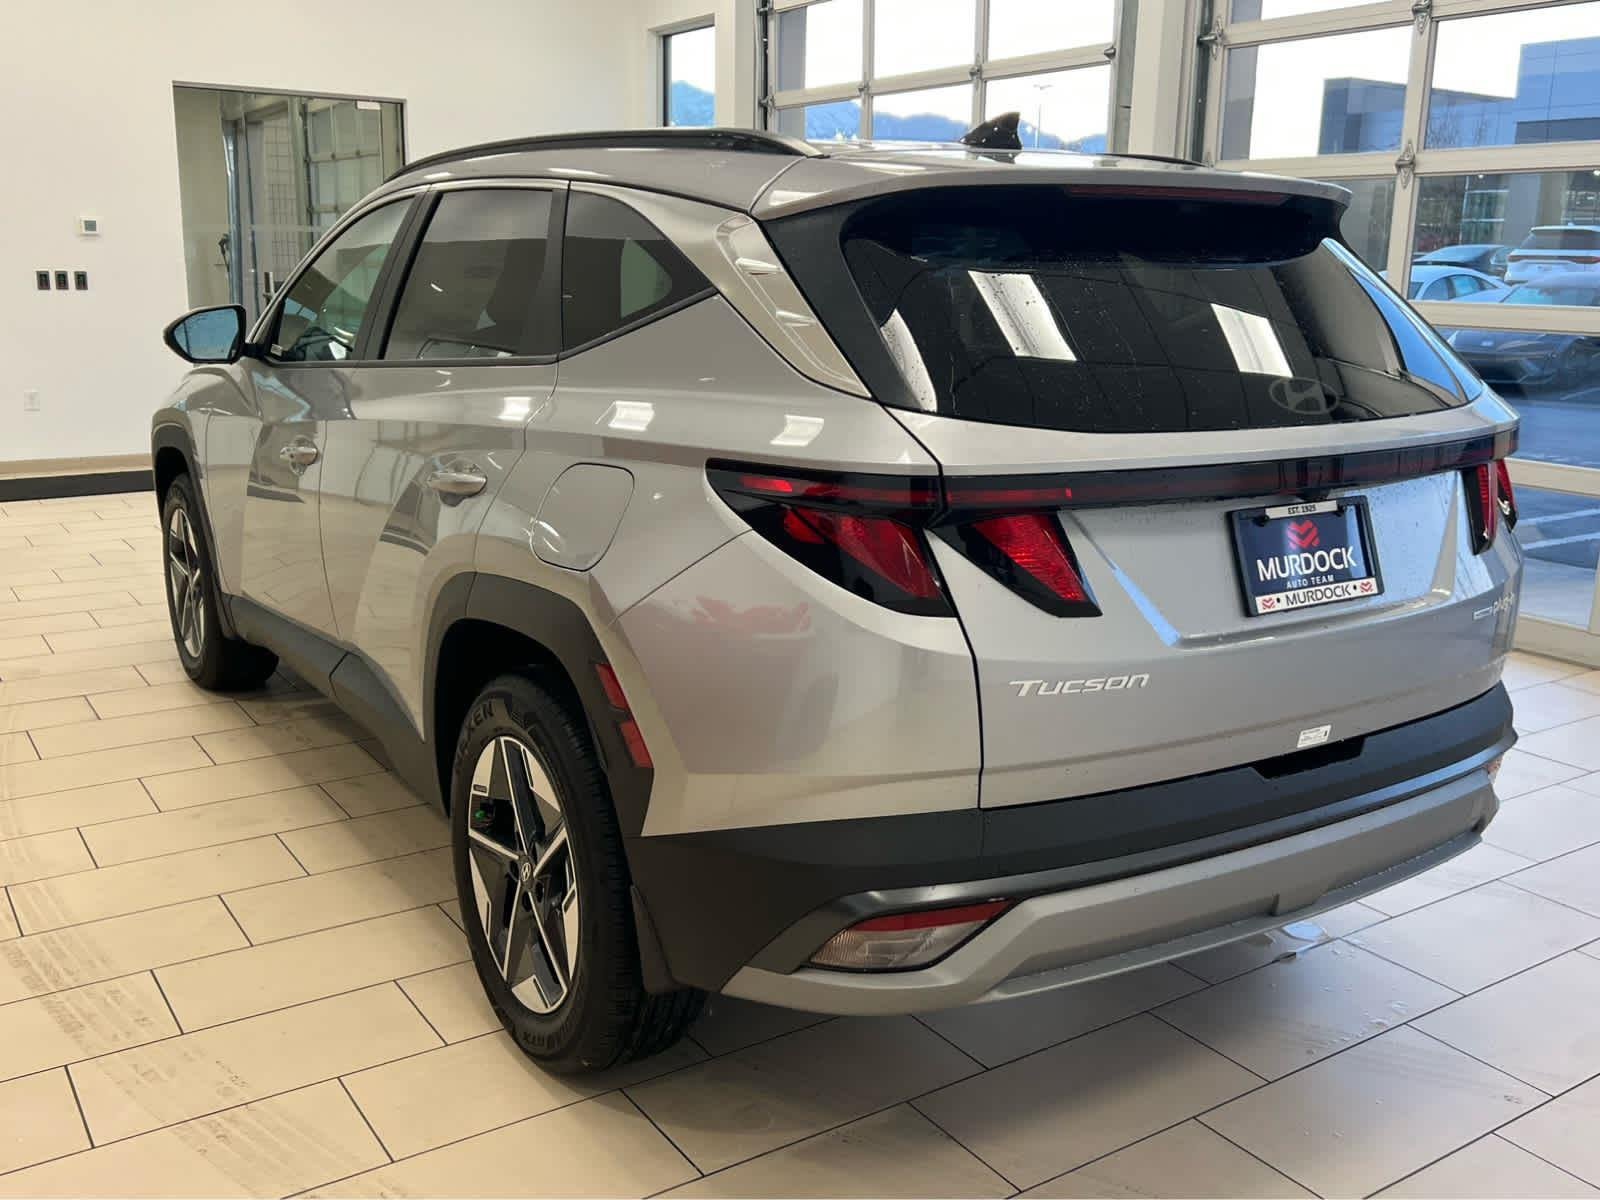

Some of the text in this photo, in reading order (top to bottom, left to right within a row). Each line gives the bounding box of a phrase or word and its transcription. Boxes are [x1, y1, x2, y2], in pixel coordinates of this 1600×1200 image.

[1256, 546, 1357, 582] MURDOCK
[1286, 574, 1335, 589] AUTO TEAM
[1285, 584, 1351, 607] MURDOCK
